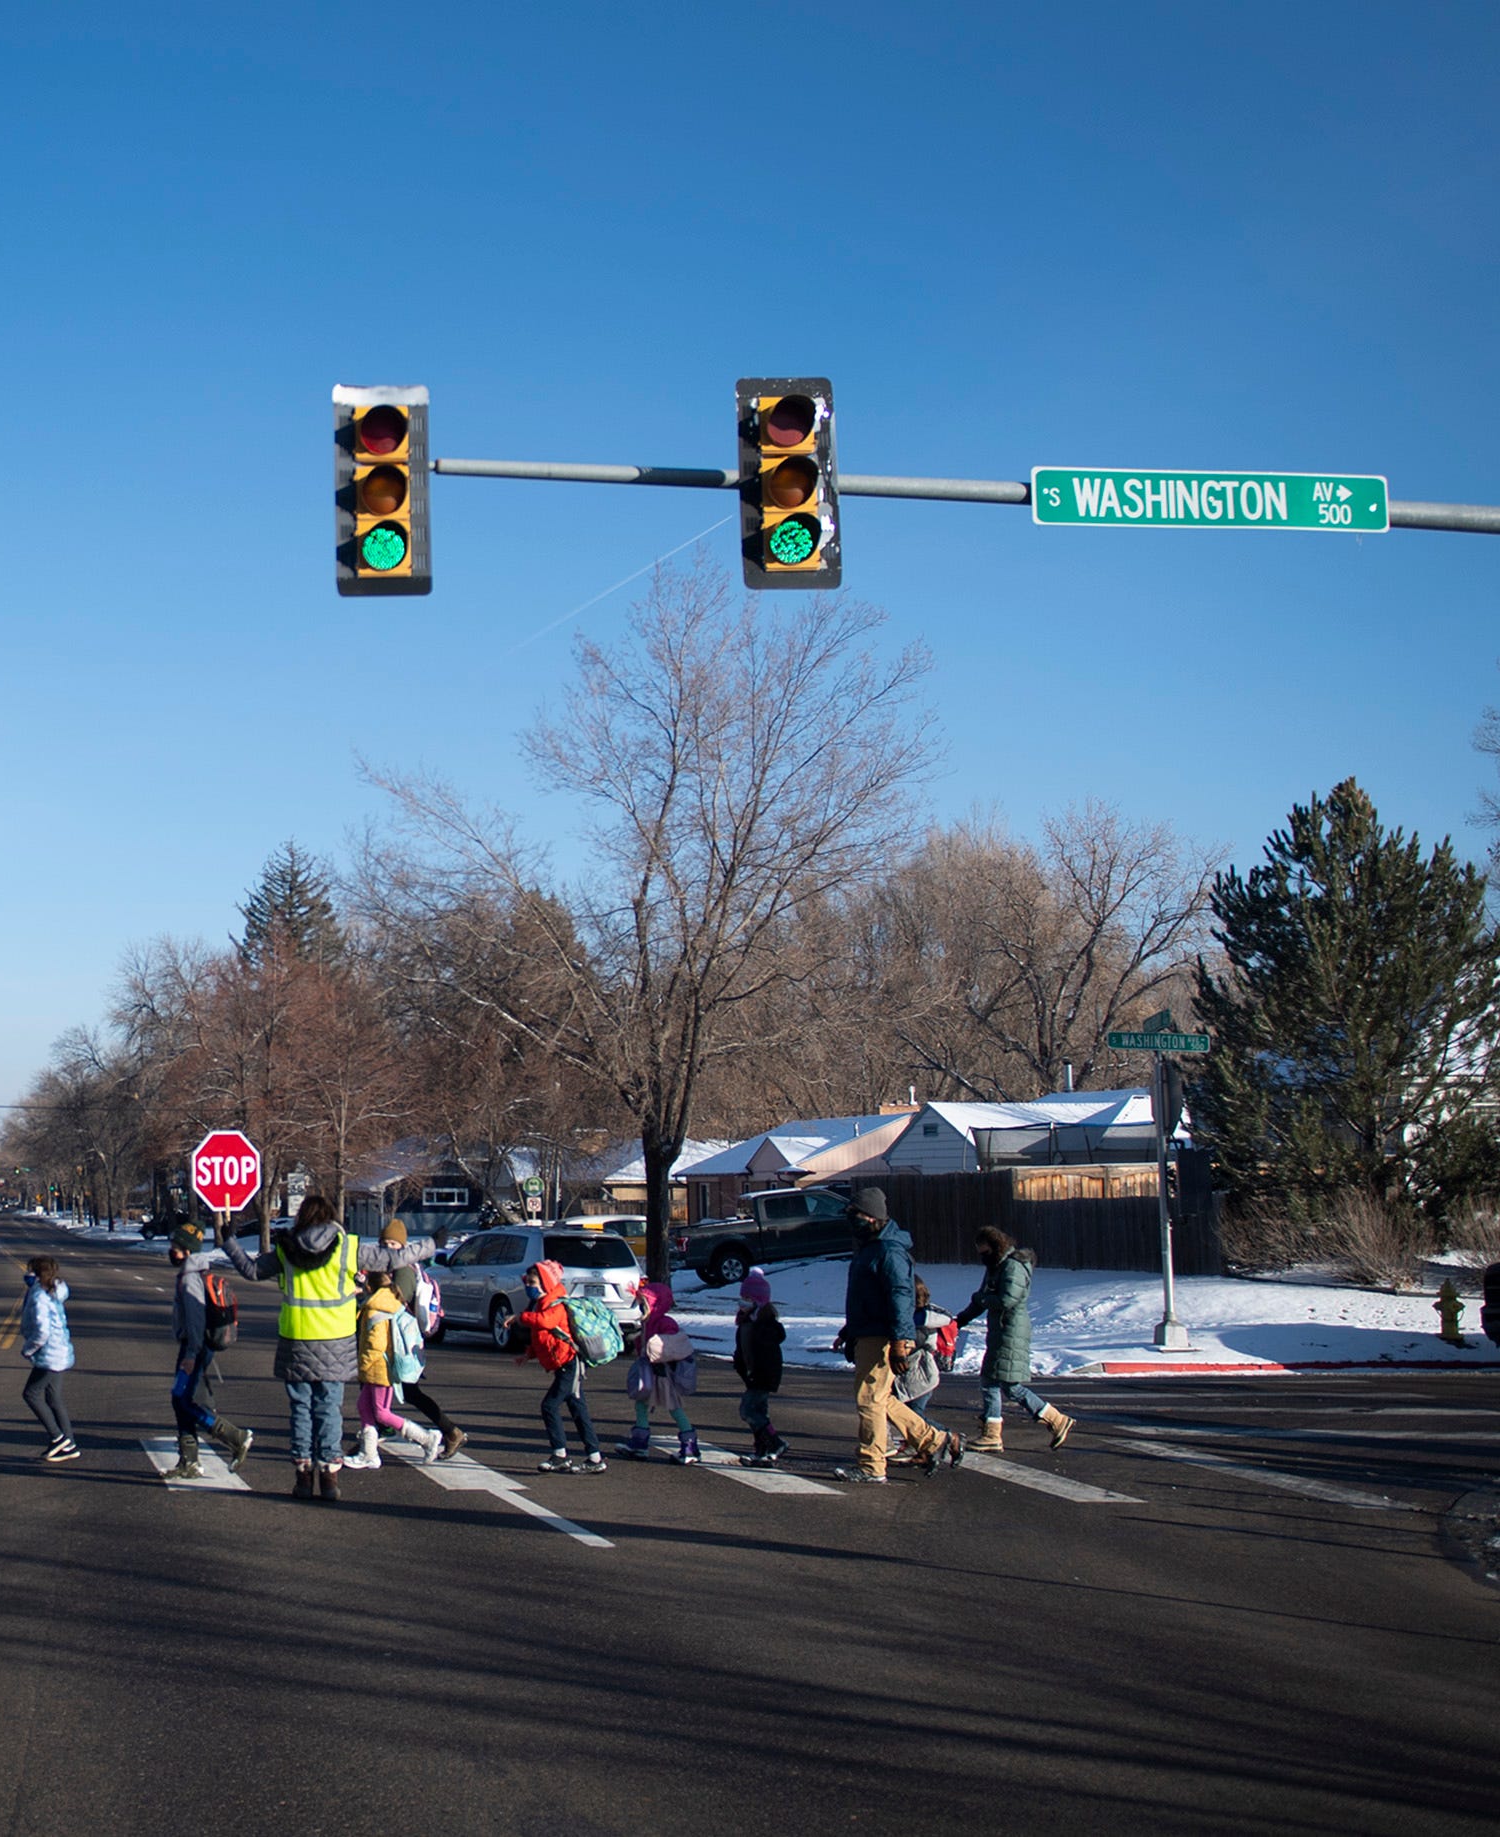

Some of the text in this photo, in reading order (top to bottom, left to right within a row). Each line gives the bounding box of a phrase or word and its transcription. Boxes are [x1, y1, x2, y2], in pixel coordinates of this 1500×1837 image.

[1049, 477, 1334, 521] S WASHINGTON AV
[1318, 503, 1352, 524] 500
[1121, 1034, 1186, 1049] WASHINGTON
[197, 1156, 255, 1186] STOP
